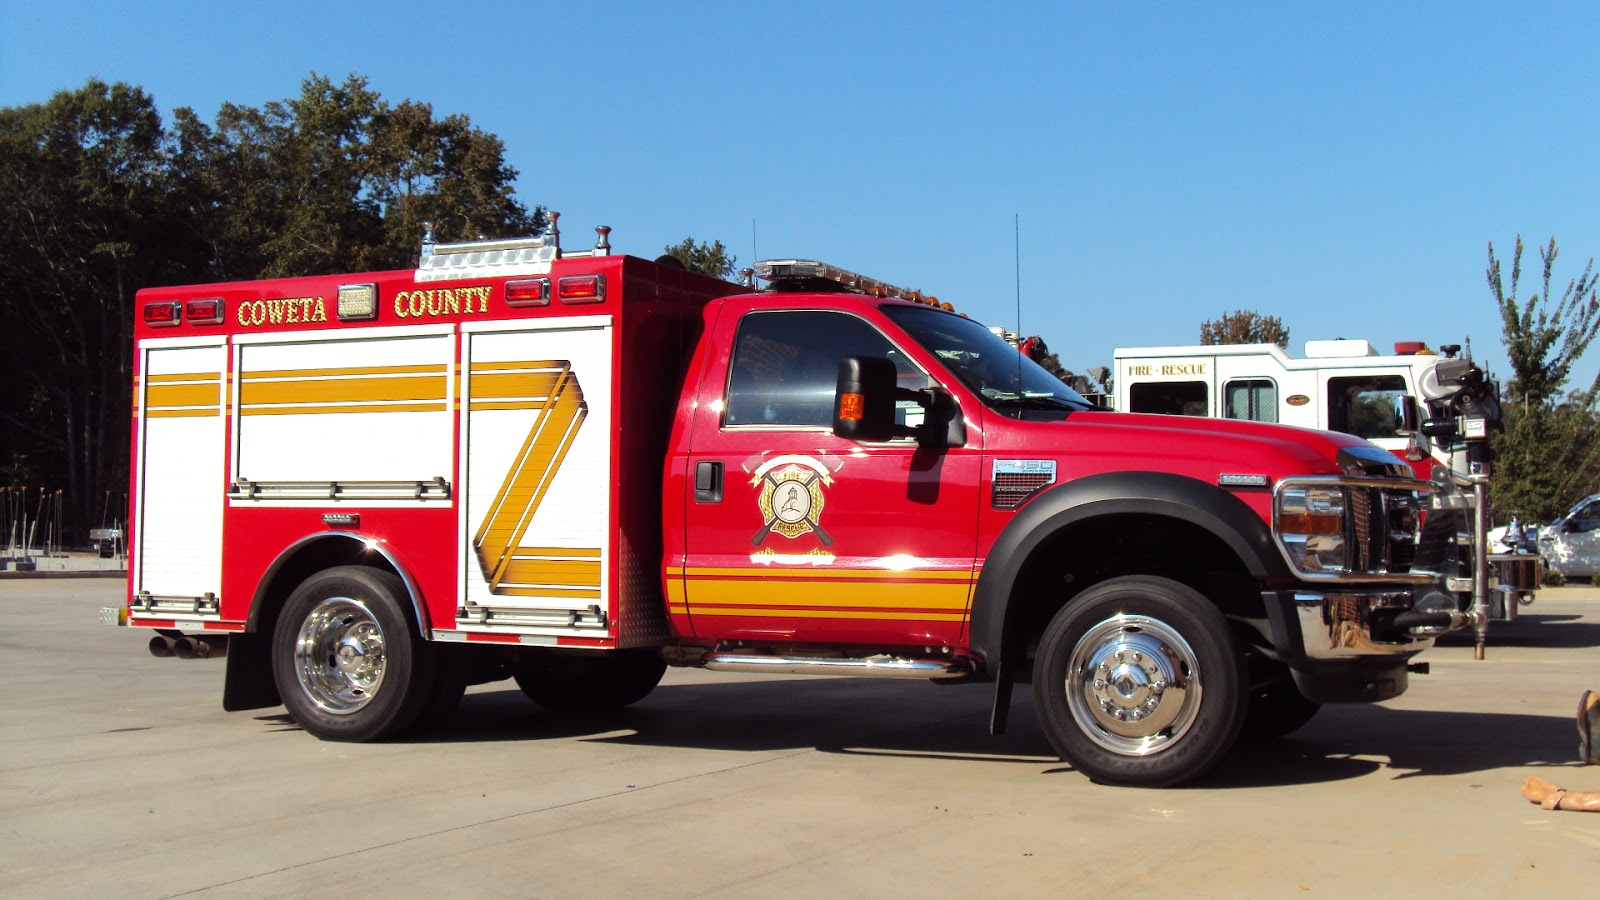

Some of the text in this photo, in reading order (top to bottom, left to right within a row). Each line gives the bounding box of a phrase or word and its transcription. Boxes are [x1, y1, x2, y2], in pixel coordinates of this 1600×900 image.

[237, 286, 492, 326] COWETA COUNTY
[1128, 363, 1207, 376] FIRE RESCUE
[783, 471, 801, 480] FIRE
[778, 521, 805, 531] RESCUE
